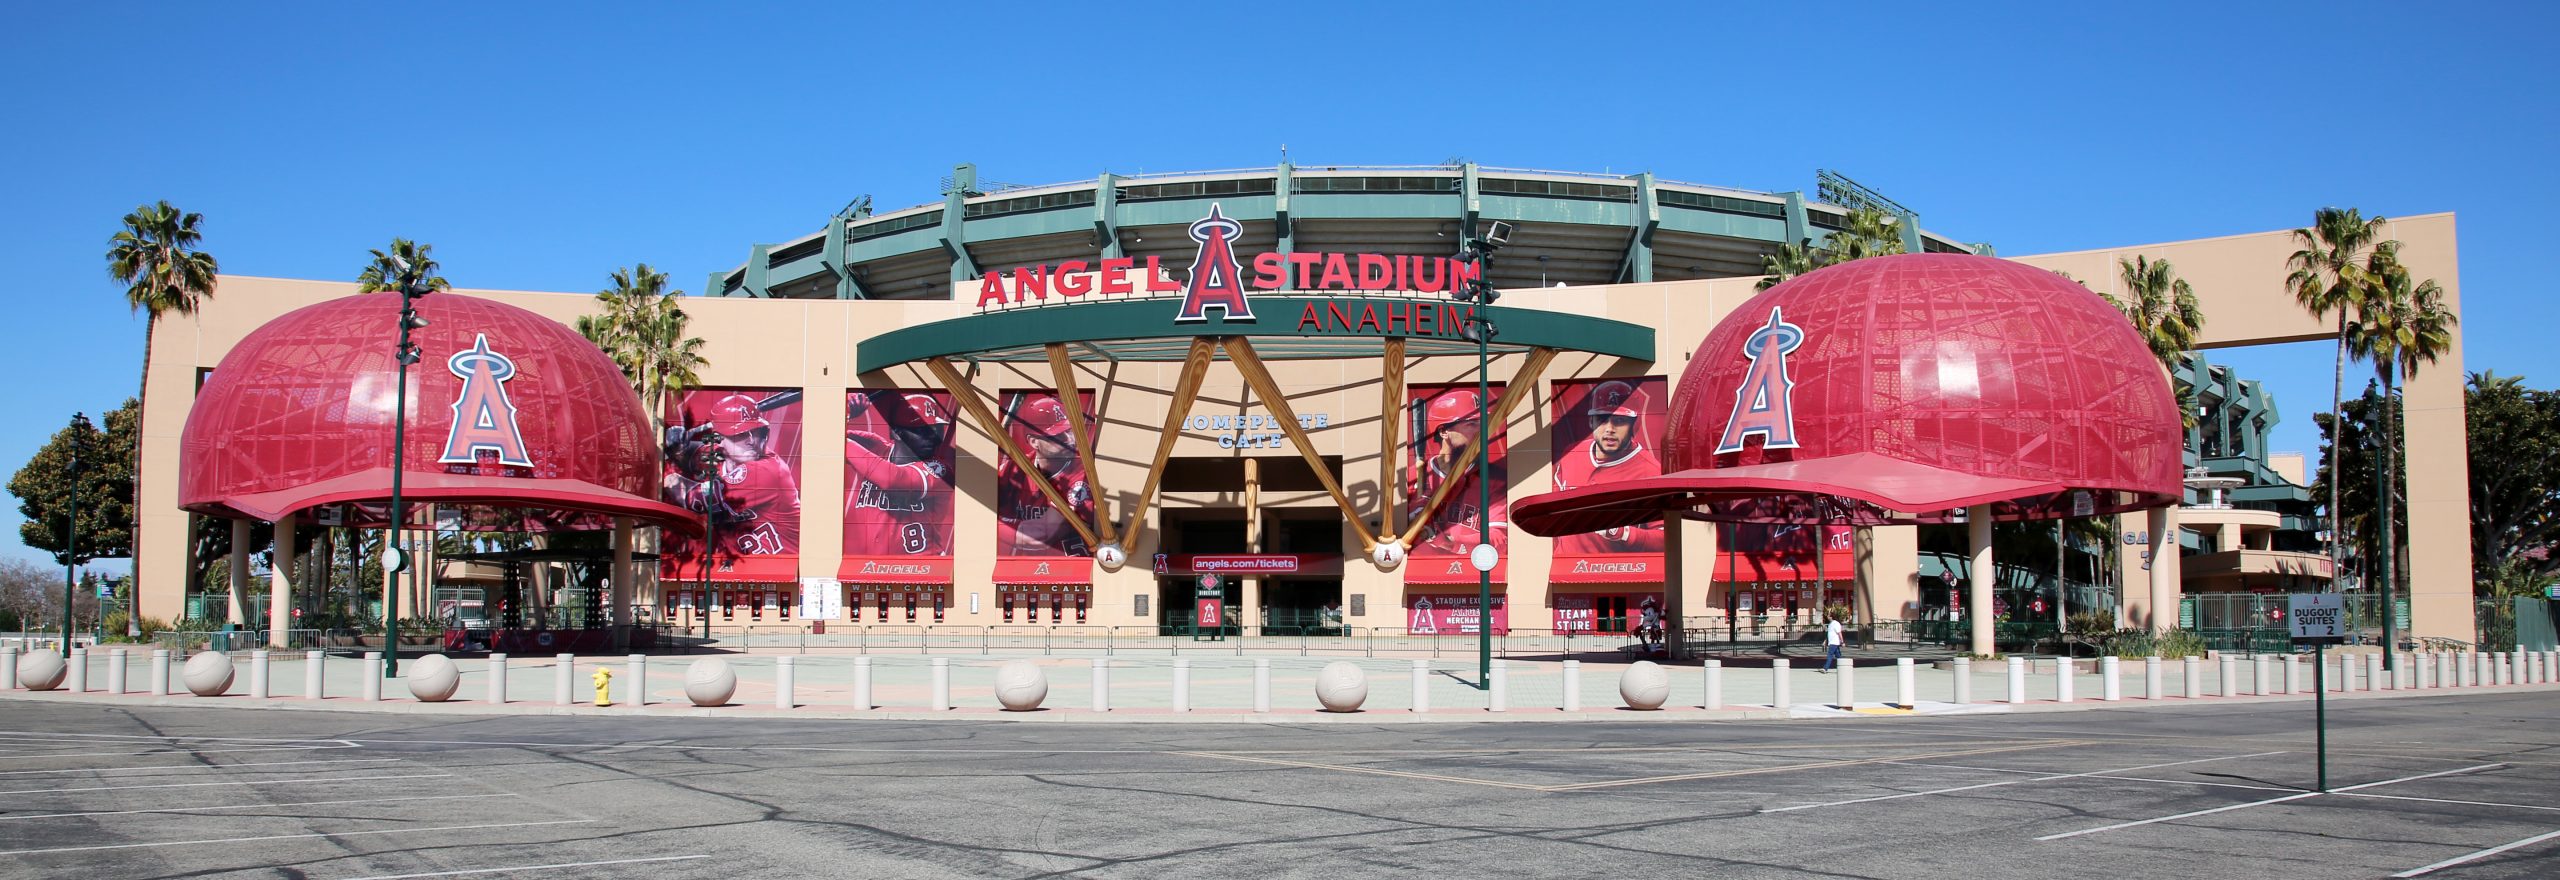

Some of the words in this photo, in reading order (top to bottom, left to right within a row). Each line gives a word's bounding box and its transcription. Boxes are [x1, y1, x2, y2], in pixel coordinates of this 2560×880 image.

[977, 255, 1182, 307] ANGEL
[1252, 251, 1482, 295] STADIUM
[1297, 301, 1475, 336] ANAHEIM
[1181, 413, 1328, 430] OMEPLTE
[1218, 433, 1281, 448] GATE
[902, 522, 927, 554] 8
[2122, 531, 2174, 545] GAE
[1196, 559, 1295, 570] angels.com/tickets
[1435, 597, 1467, 605] STADIUM
[1469, 597, 1505, 605] EXCSIVE
[2035, 601, 2042, 612] 3
[1559, 609, 1586, 619] TEAM
[2294, 608, 2339, 617] DUGOUT
[1446, 616, 1495, 624] MERCHANE
[1557, 621, 1591, 630] STORE
[2298, 616, 2335, 626] SUITES
[2301, 626, 2307, 635] 1
[2327, 626, 2334, 635] 2
